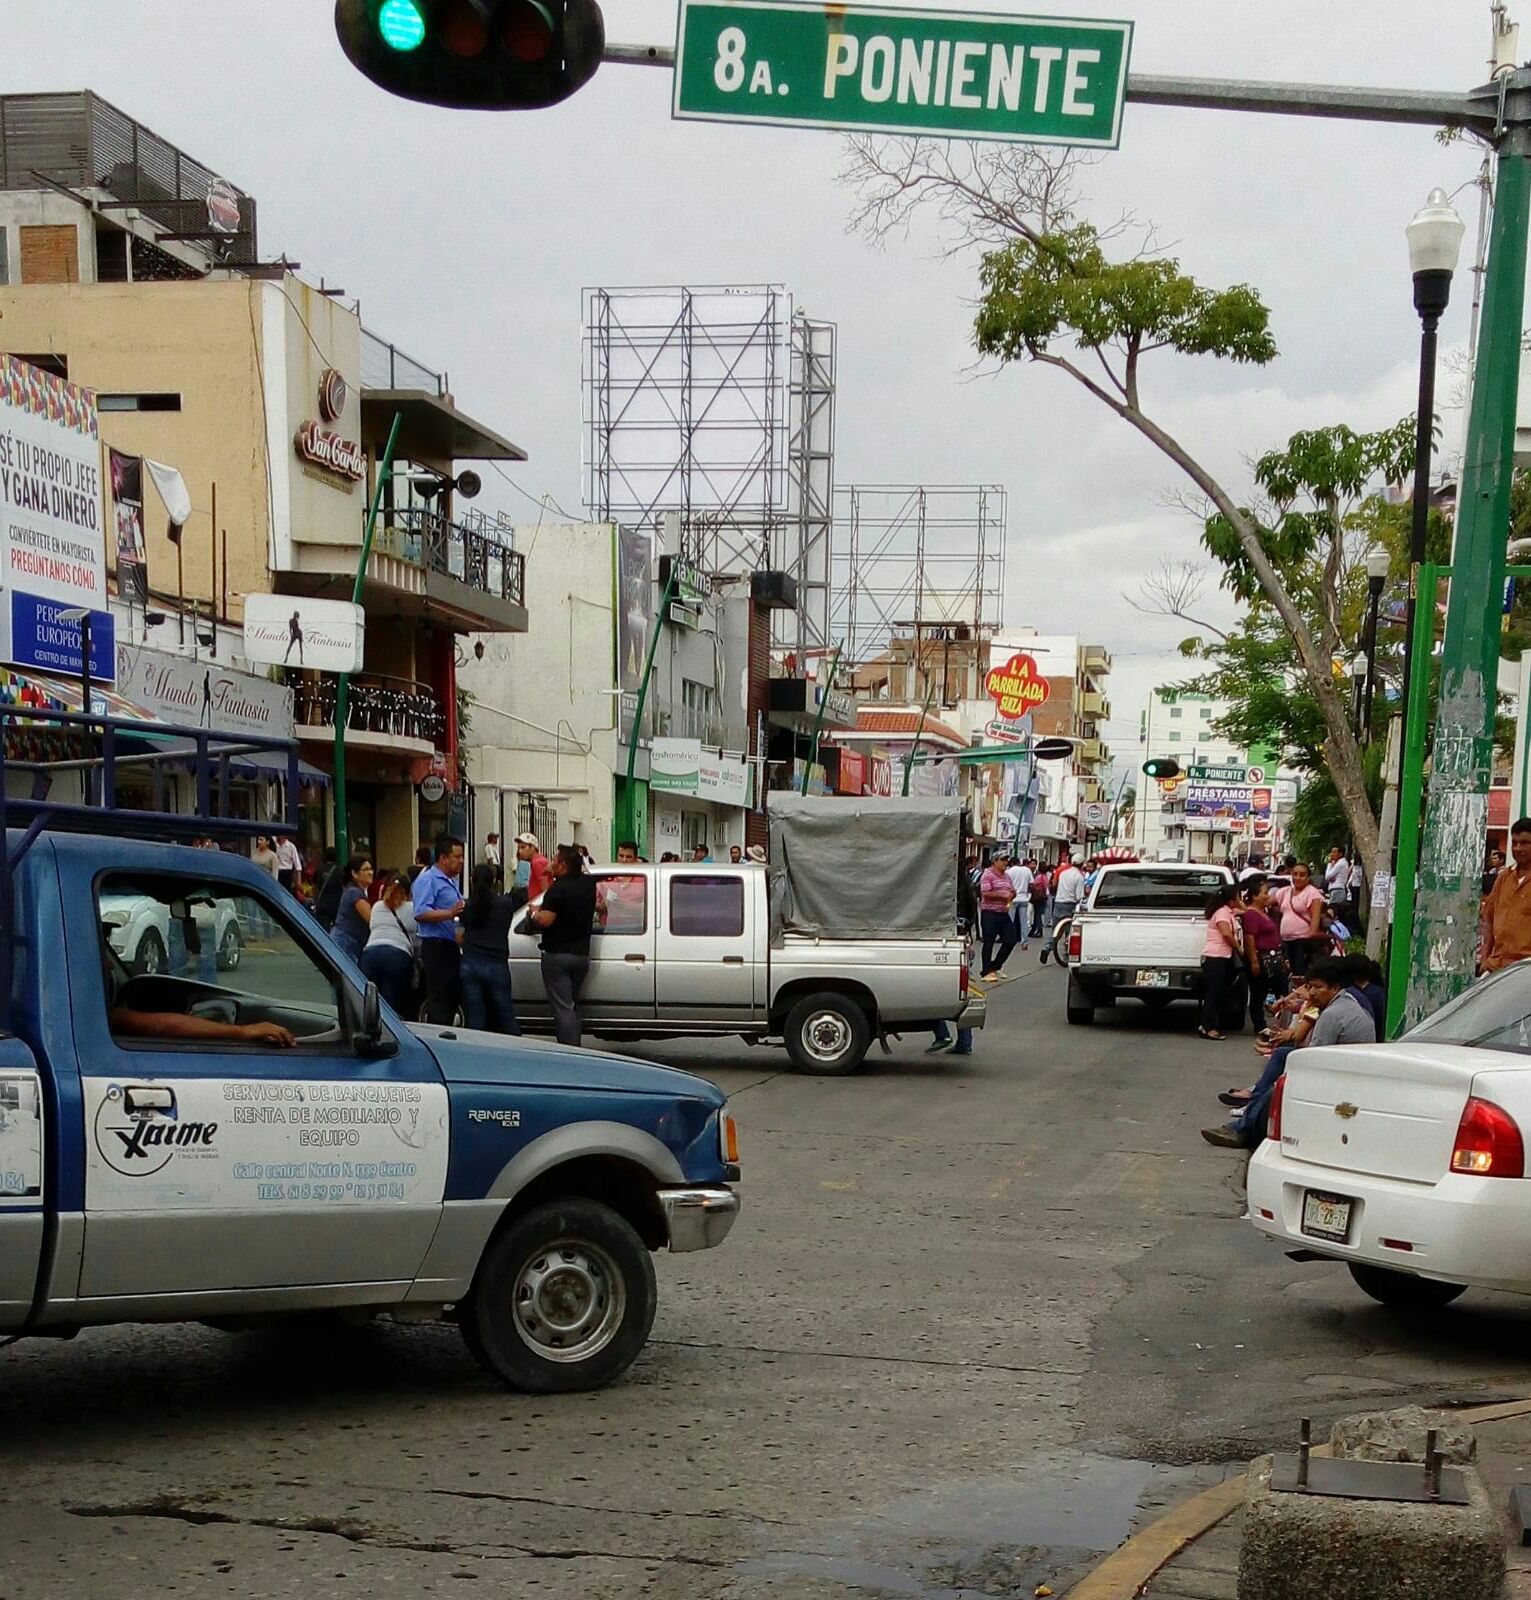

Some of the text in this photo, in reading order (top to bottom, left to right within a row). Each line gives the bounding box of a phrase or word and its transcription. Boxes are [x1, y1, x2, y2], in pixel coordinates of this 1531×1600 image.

[823, 33, 1101, 117] PONIENTE
[308, 425, 330, 460] San
[0, 429, 98, 497] SÉ TU PROPIO JEFE
[2, 468, 100, 532] Y GANA DINERO.
[9, 525, 50, 552] CONVIÉRTETE
[52, 537, 60, 554] EN
[11, 548, 70, 587] PREGÚNTANOS
[72, 563, 98, 592] CÓMO.
[36, 604, 82, 630] PERFME
[246, 628, 289, 643] Mundo
[34, 649, 59, 664] CENTRO
[60, 656, 68, 665] DE
[1010, 659, 1029, 679] LA
[143, 666, 198, 706] Mundo
[988, 672, 1044, 702] PARRILLADA
[1000, 695, 1023, 716] SUIZA
[1205, 769, 1243, 780] PONIENTE
[222, 1083, 421, 1103] SERVICIOS DE BANQUETES
[233, 1106, 420, 1124] RENTA DE MOBILIARIO Y
[469, 1110, 520, 1122] RANGER
[300, 1129, 360, 1147] EQUIPO
[233, 1161, 263, 1179] Calle
[309, 1161, 341, 1178] Norte
[379, 1160, 416, 1177] Centro
